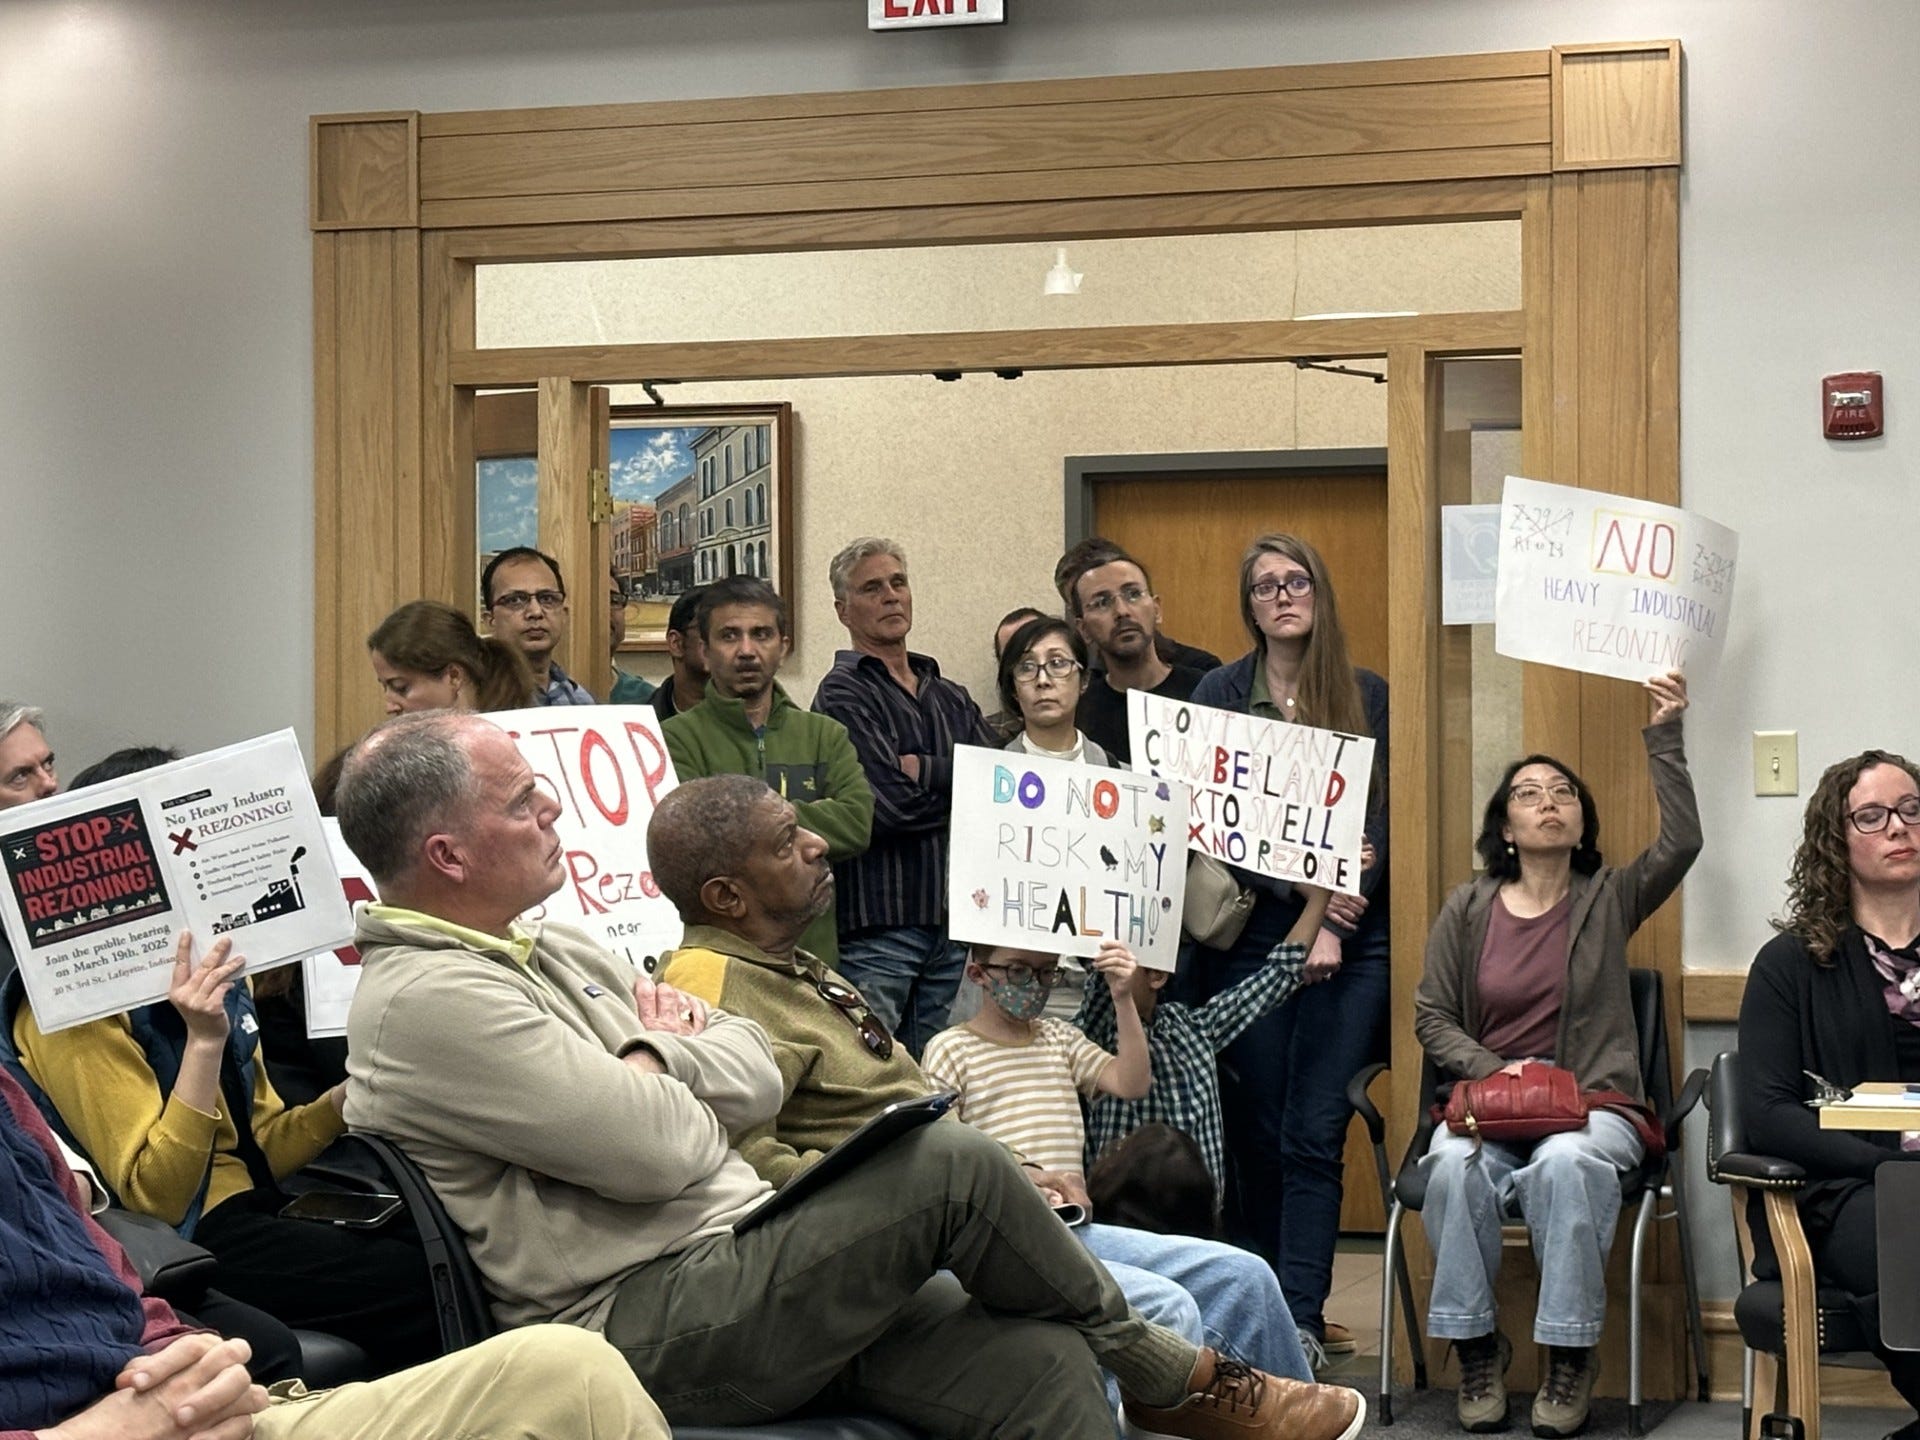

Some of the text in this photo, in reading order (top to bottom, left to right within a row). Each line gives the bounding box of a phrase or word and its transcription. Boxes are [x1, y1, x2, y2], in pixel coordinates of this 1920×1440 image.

[1836, 409, 1865, 419] FIRE
[1596, 519, 1675, 579] NO
[1544, 576, 1600, 607] HEAVY
[1630, 587, 1717, 638] INDUSTRIAL
[1572, 619, 1689, 668] REZONING
[1142, 696, 1359, 769] I DON'T WANT
[1145, 729, 1346, 808] CUMBERLAND
[165, 786, 286, 827] No Heavy Industry
[198, 800, 293, 837] REZONING!
[993, 765, 1046, 809] DO
[1066, 778, 1148, 828] NOT
[1245, 796, 1334, 851] SMELL
[35, 816, 113, 862] STOP
[997, 822, 1166, 892] RISK MY
[1257, 839, 1348, 888] REZONE
[16, 840, 150, 895] INDUSTRIAL
[24, 864, 156, 922] REZONING!
[566, 851, 661, 915] Rezo
[607, 922, 642, 938] near
[1002, 877, 1160, 947] HEALTH!
[46, 925, 171, 966] Join the public hearing
[55, 969, 69, 978] on
[74, 956, 109, 974] March
[141, 938, 169, 954] 2025
[53, 986, 64, 996] 20
[76, 979, 90, 989] 3rd
[148, 957, 177, 969] Indian
